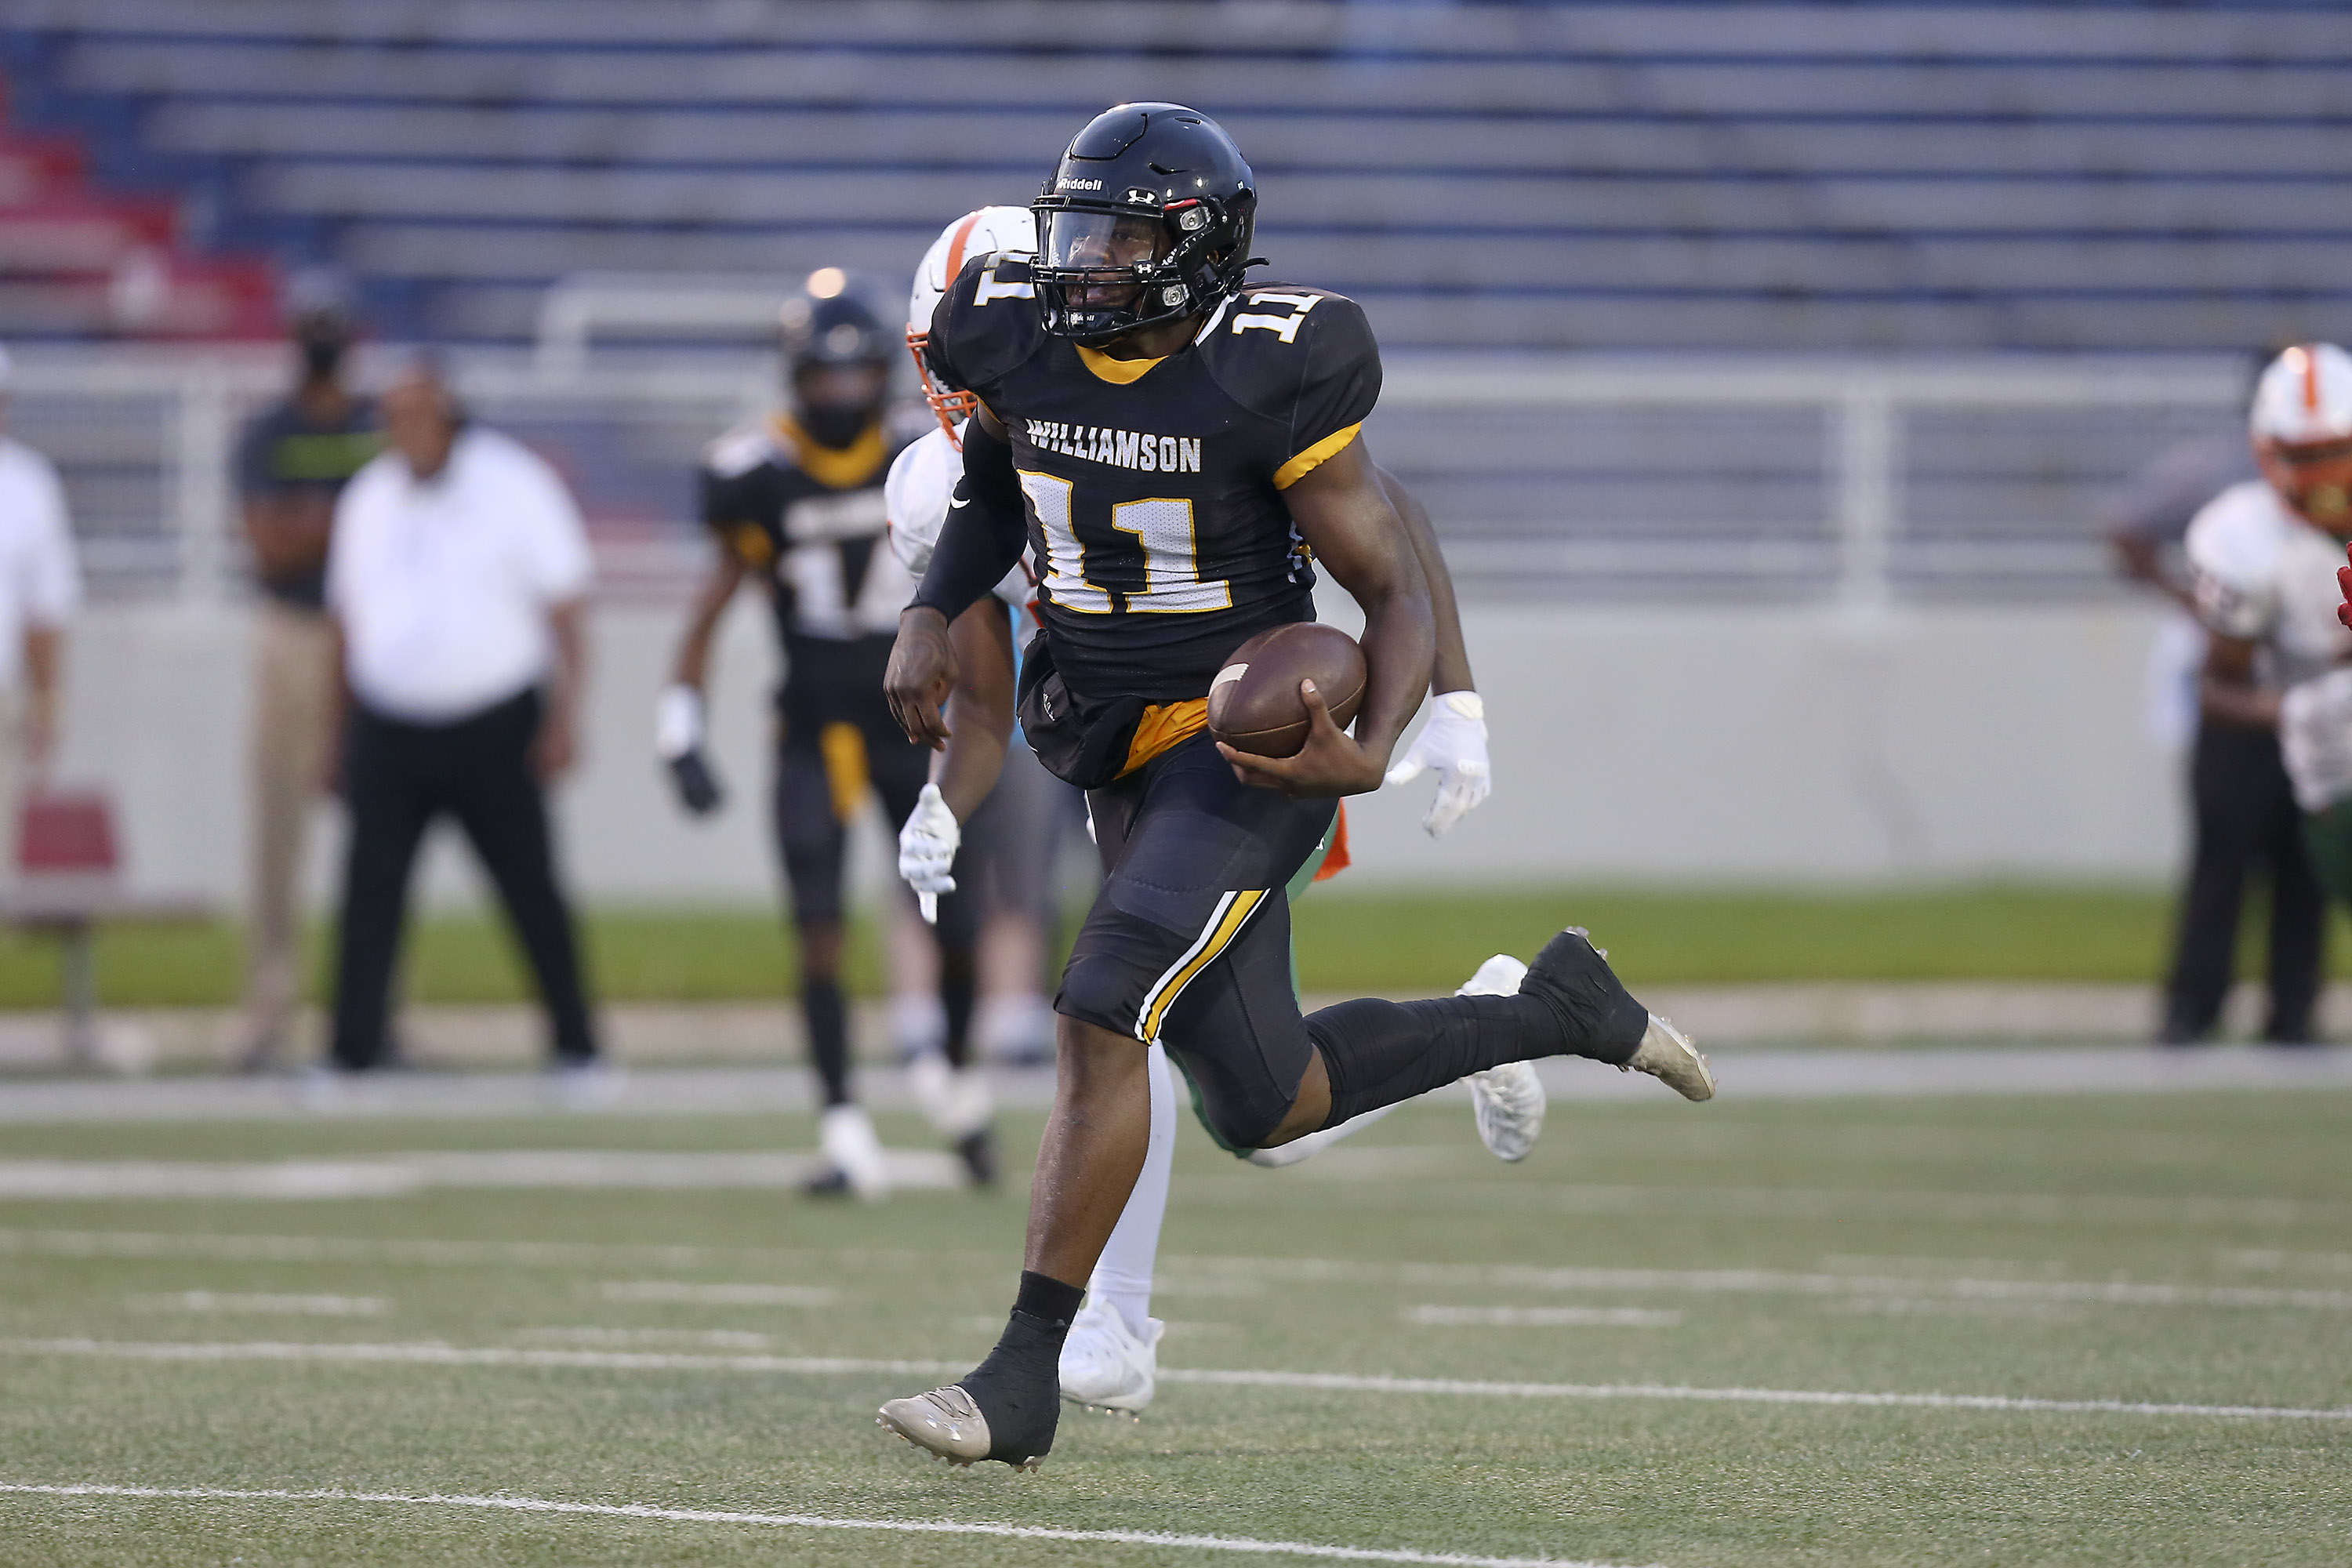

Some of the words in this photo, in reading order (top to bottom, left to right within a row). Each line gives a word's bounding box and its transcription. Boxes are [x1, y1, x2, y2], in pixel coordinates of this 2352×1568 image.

[1058, 178, 1102, 191] Riddell
[1232, 292, 1325, 344] 11
[1025, 418, 1201, 473] WILLIAMSON
[1016, 469, 1233, 615] 11
